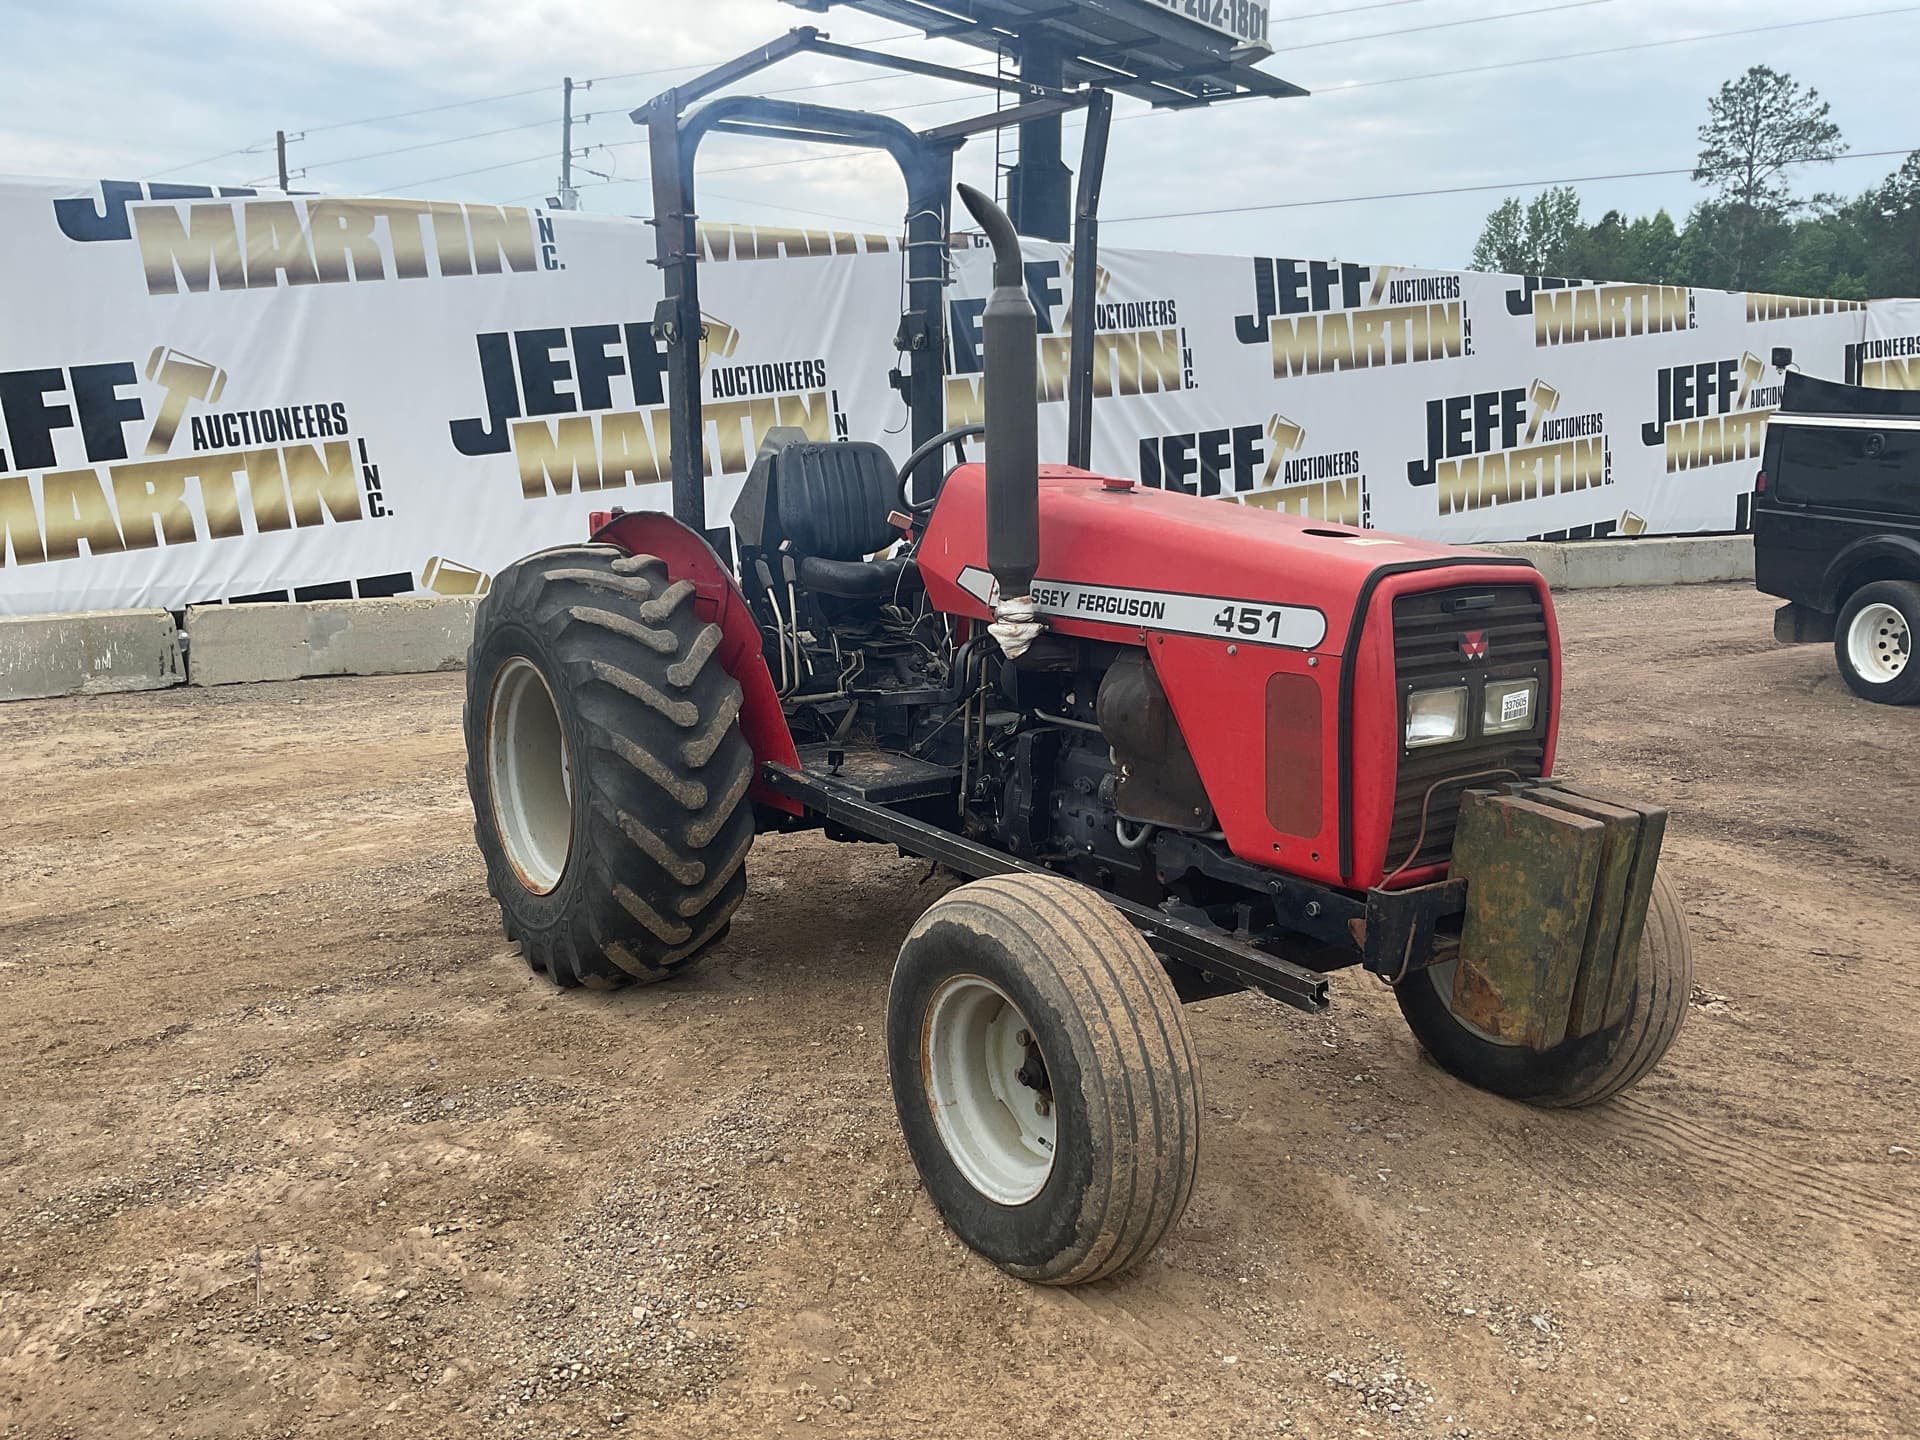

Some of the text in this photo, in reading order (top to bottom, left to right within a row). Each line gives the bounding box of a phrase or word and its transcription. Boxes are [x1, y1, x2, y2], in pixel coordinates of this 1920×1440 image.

[132, 199, 537, 295] MARTIN
[1094, 300, 1176, 330] UCTIONEERS
[1234, 257, 1371, 344] JEFF
[1389, 275, 1460, 304] AUCTIONEERS
[1534, 285, 1687, 347] MARTIN
[1272, 302, 1462, 379] MARTIN
[1463, 300, 1476, 356] INC.
[711, 359, 826, 398] AUCTIONEERS
[945, 329, 1181, 444] MRTIN
[1181, 328, 1199, 390] INC.
[0, 361, 145, 472] FF
[191, 401, 348, 451] AUCTIONEERS
[832, 390, 849, 441] IN
[1641, 359, 1739, 446] JEFF
[1750, 386, 1784, 409] AUCTION
[1407, 387, 1526, 487] JEFF
[1542, 413, 1603, 443] AUCTIONEERS
[1666, 408, 1777, 474] MART
[357, 437, 394, 518] INC.
[1284, 450, 1359, 485] AUCTIONEERS
[1437, 436, 1602, 517] MARTIN
[1604, 434, 1615, 485] INC.
[1031, 587, 1166, 620] SSEY FERGUSON
[1214, 606, 1281, 639] 451
